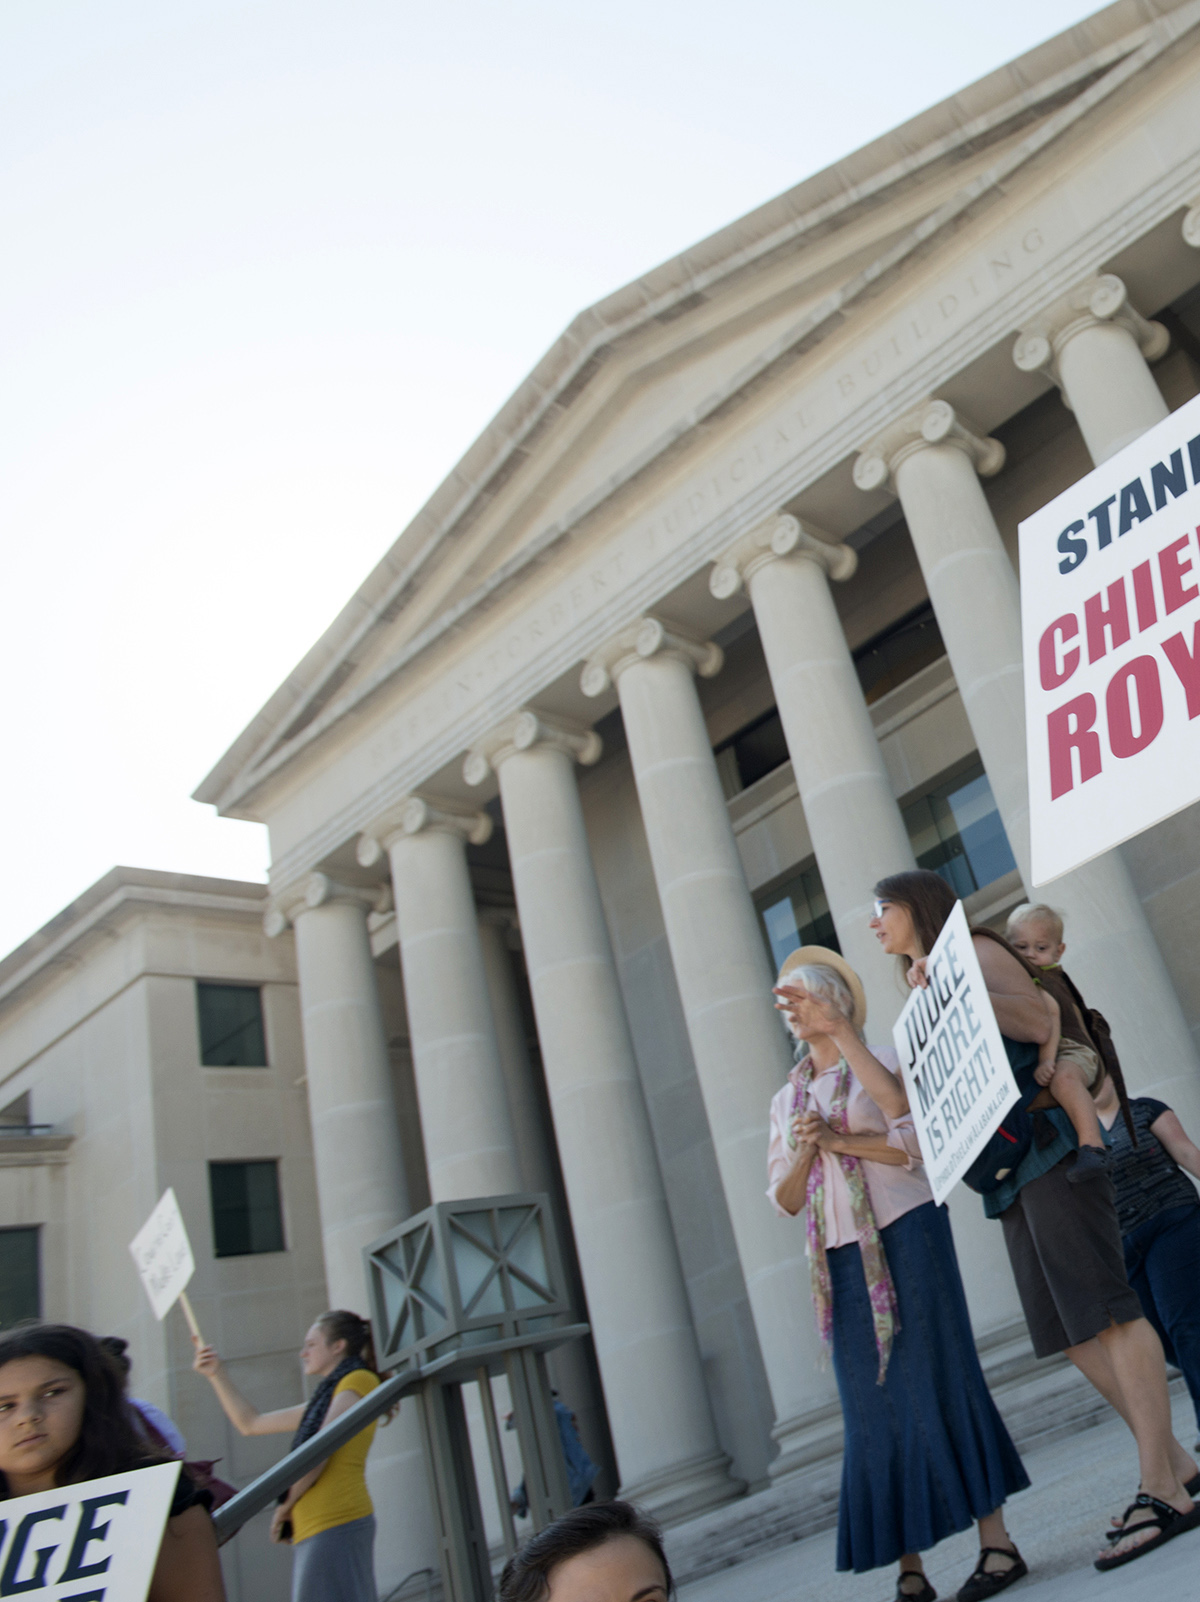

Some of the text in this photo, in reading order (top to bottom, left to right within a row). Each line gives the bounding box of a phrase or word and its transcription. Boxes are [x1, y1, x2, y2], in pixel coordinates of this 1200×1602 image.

[834, 227, 1045, 400] BUILDING
[904, 930, 966, 1071] JUDGE
[913, 984, 982, 1119] MOORE
[925, 1038, 997, 1162] IS RIGHT!
[0, 1489, 132, 1598] GE
